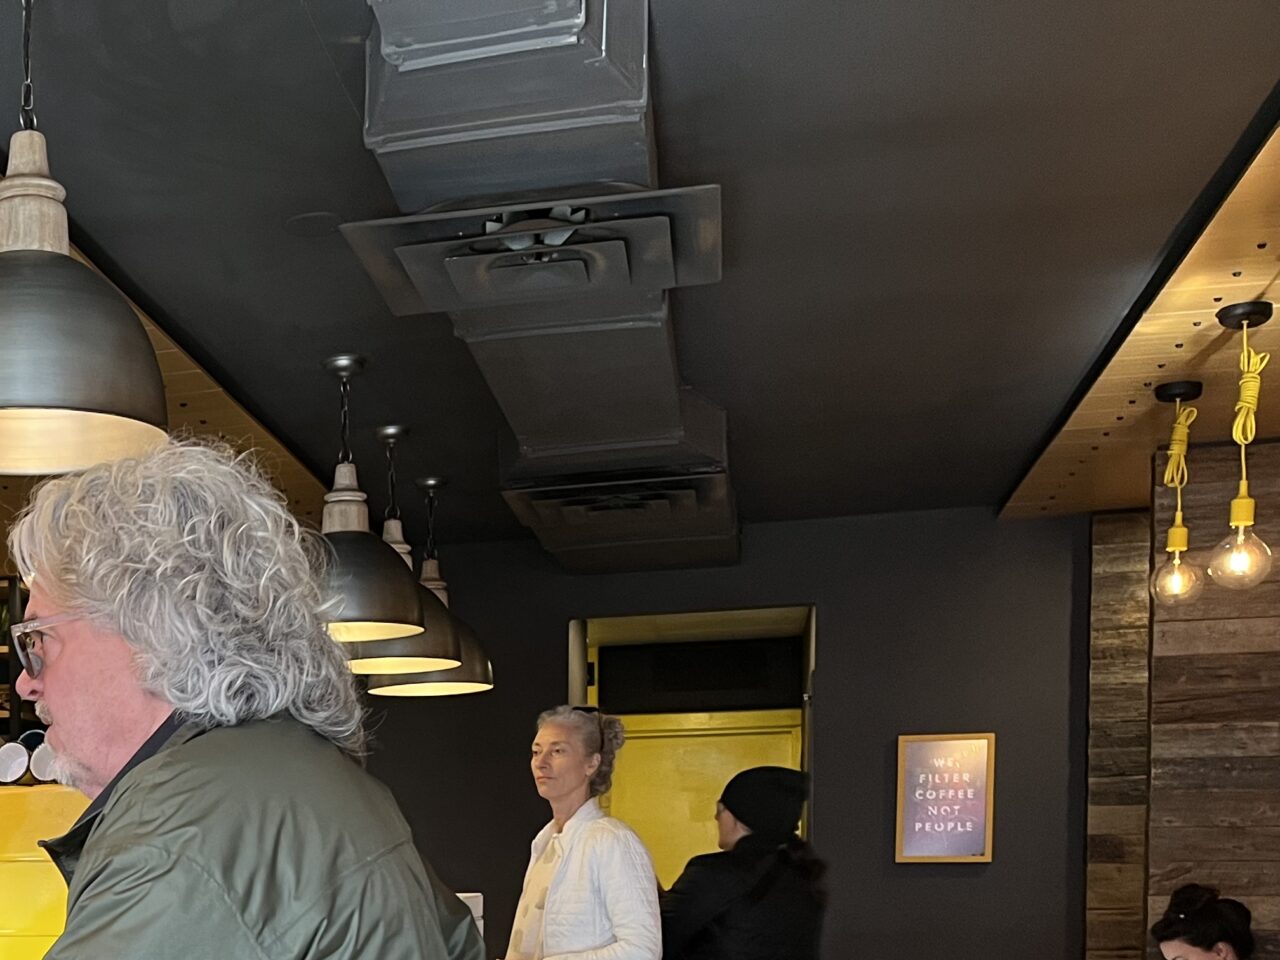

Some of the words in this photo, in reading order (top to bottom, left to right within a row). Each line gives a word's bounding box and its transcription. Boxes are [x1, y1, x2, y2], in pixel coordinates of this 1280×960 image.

[933, 757, 955, 768] WE
[919, 773, 970, 784] FILTER
[915, 788, 974, 800] COFFEE
[927, 805, 961, 816] NOT
[915, 821, 974, 832] PEOPLE
